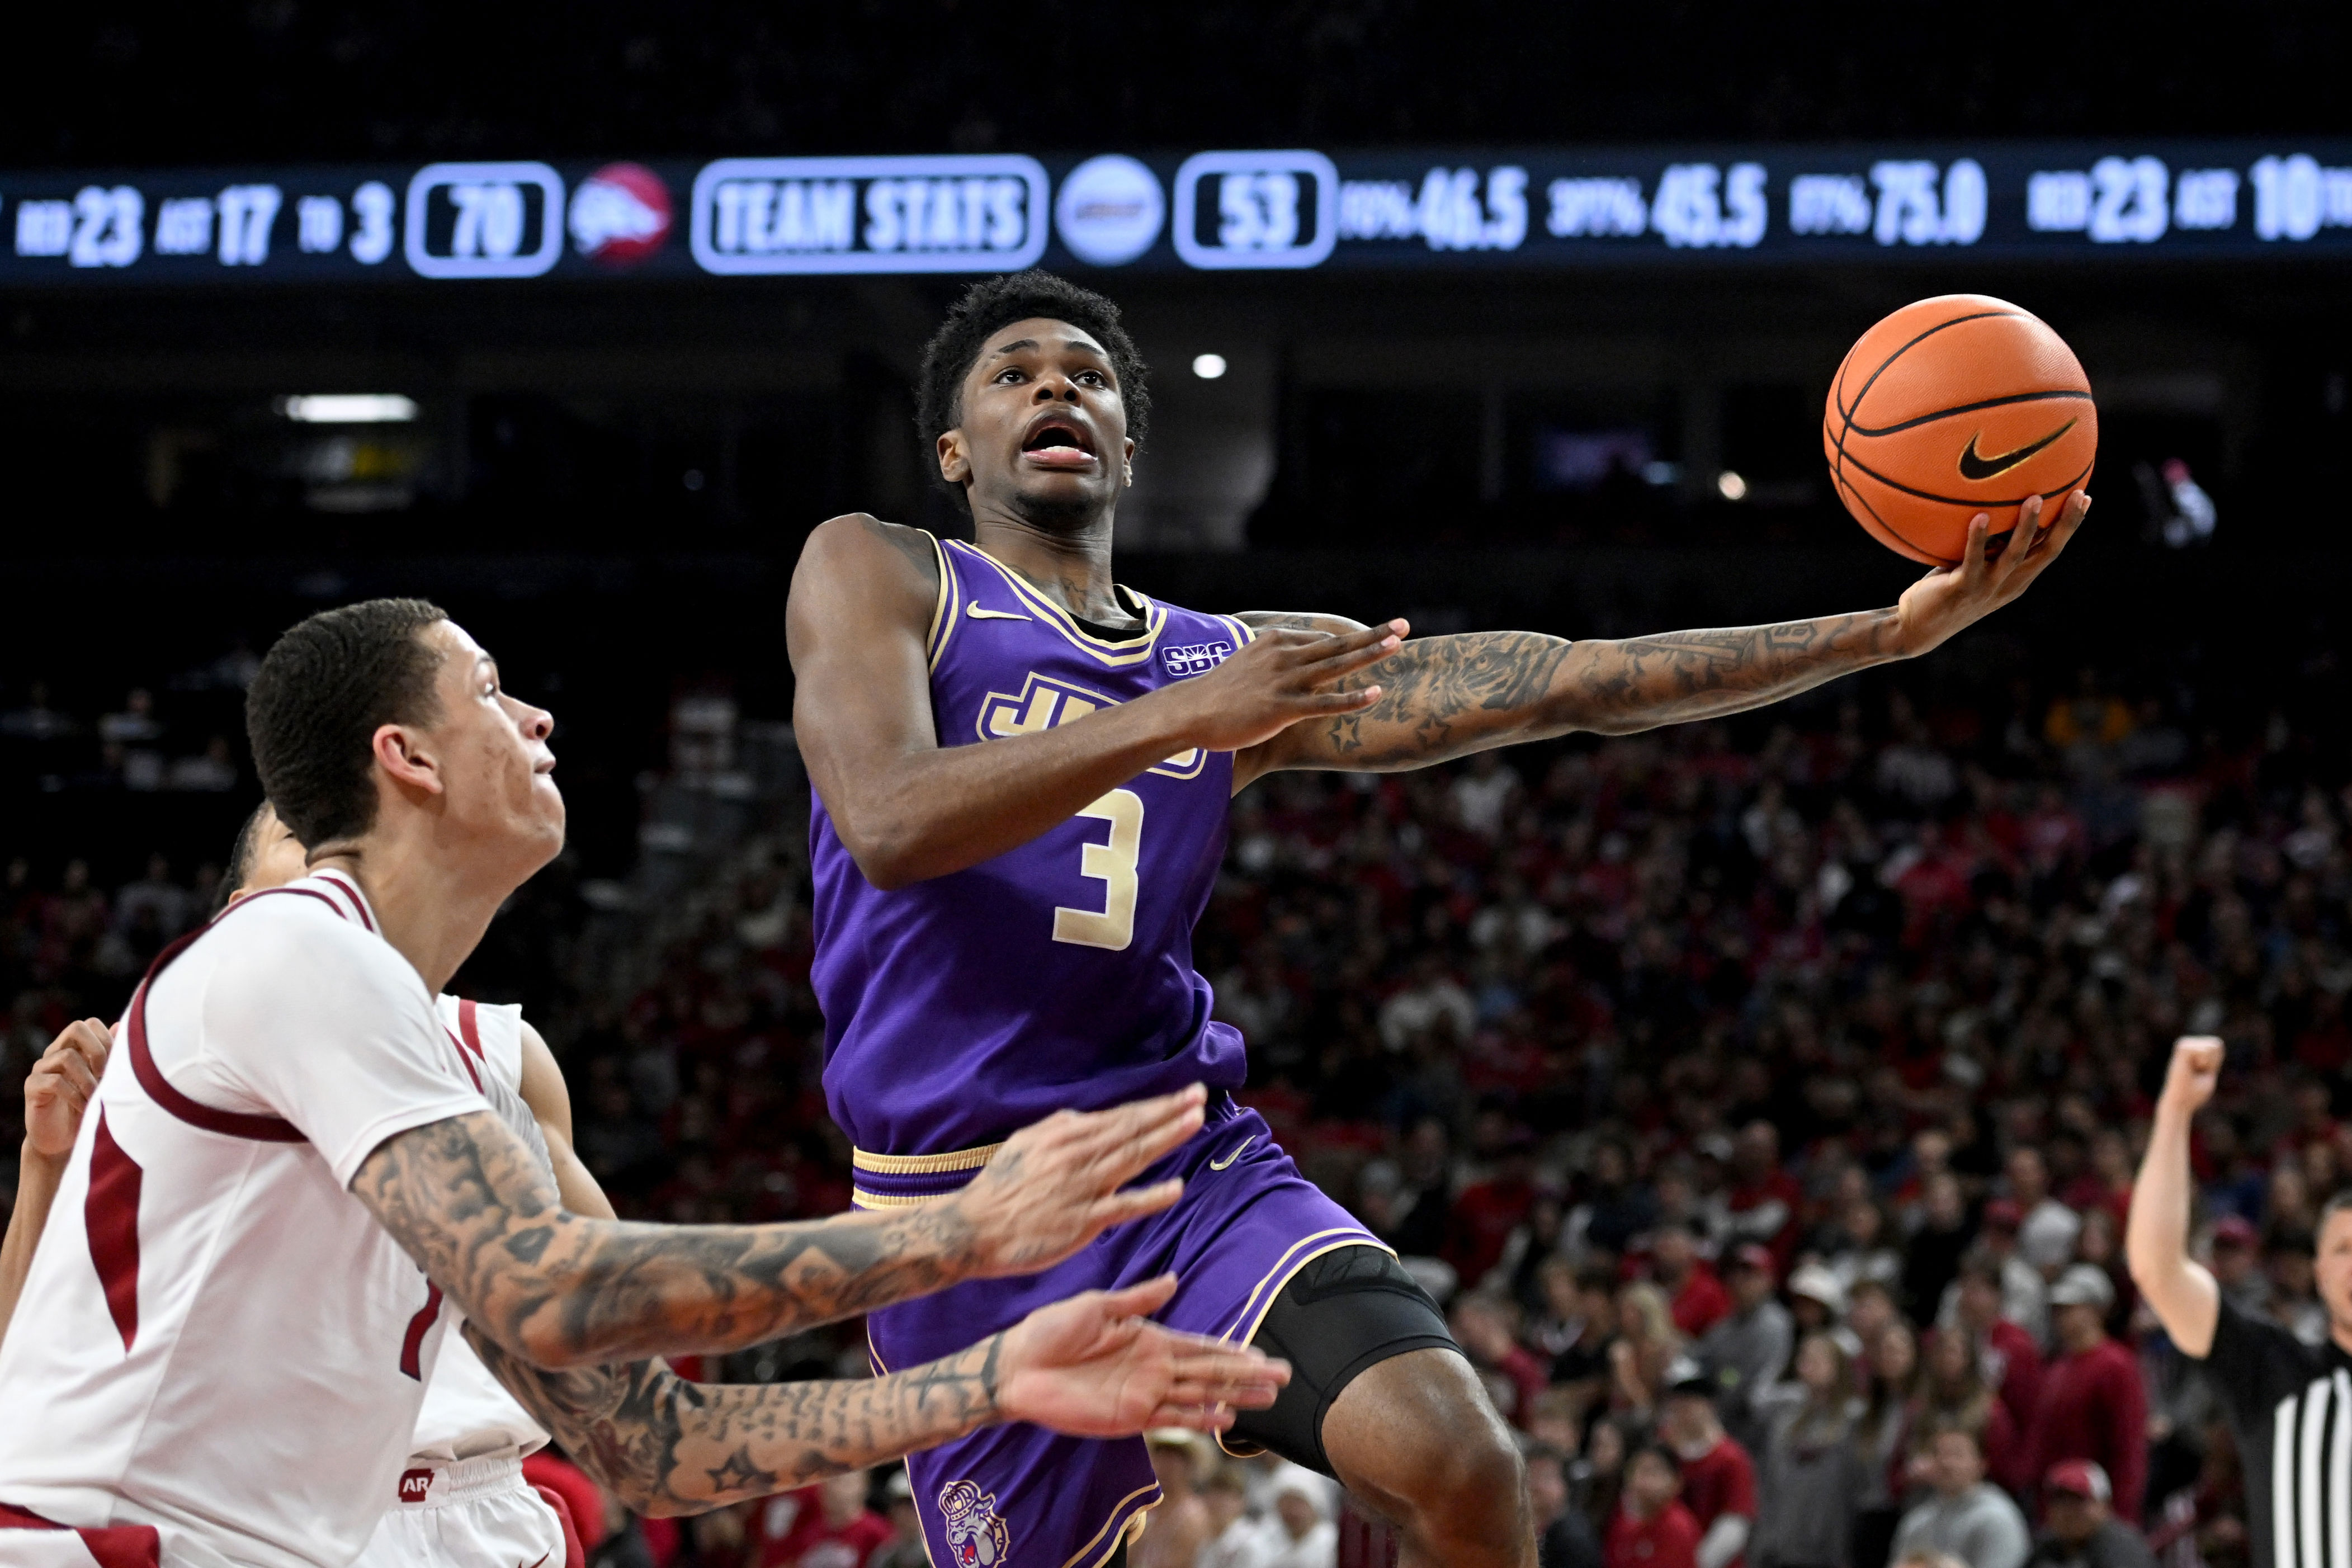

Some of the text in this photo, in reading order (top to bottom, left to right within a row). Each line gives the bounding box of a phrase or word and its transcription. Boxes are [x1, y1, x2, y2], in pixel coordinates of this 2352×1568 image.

[70, 186, 143, 267] 23
[218, 185, 281, 265] 17
[350, 182, 394, 264] 3
[449, 183, 525, 258] 70
[717, 178, 1023, 252] TEAM STATS
[1219, 174, 1299, 251] 53
[1416, 167, 1528, 251] 46.5
[1651, 163, 1767, 248] 45.5
[1869, 159, 1987, 245] 75.0
[2087, 157, 2168, 242] 23
[2251, 154, 2322, 240] 10
[1162, 641, 1231, 676] SBC
[1052, 788, 1144, 951] 3
[402, 1477, 428, 1493] AR
